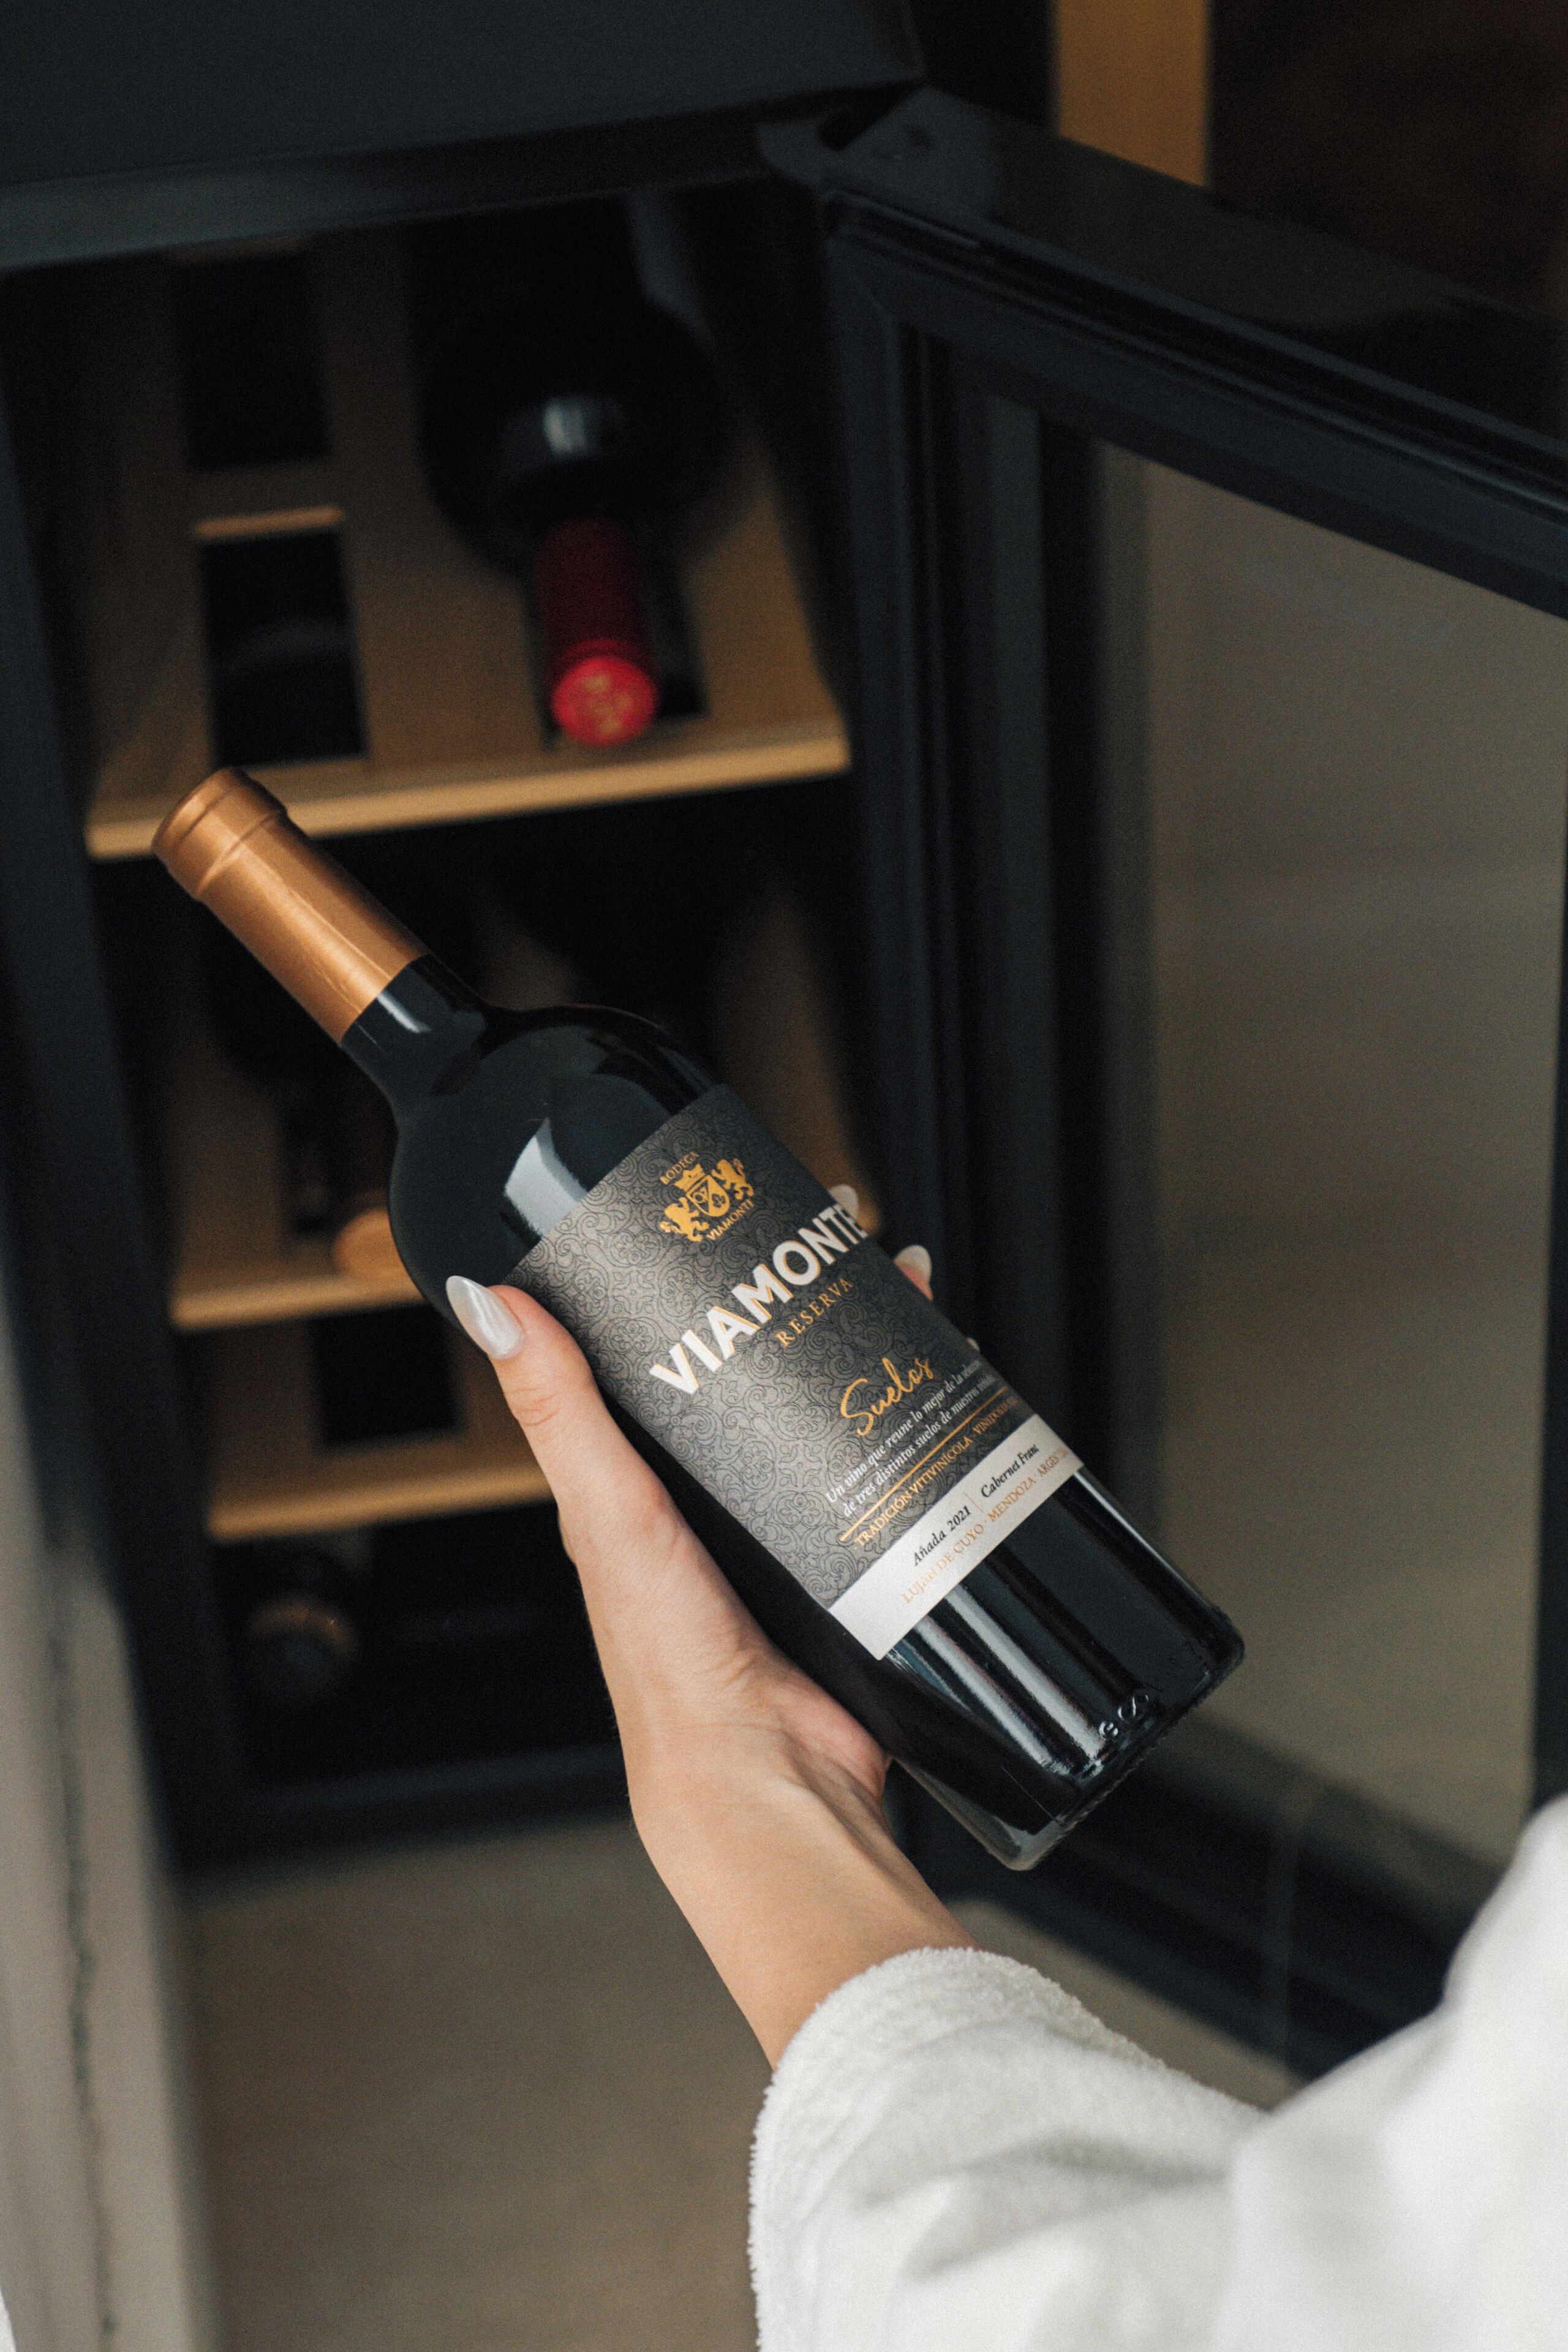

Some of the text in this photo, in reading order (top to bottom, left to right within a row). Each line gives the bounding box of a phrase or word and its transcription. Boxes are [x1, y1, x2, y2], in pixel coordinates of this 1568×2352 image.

[659, 1152, 699, 1185] BODEGA
[649, 1204, 869, 1394] VIAMONTE
[776, 1278, 853, 1348] RESERVA
[826, 1484, 846, 1502] Un
[844, 1462, 867, 1487] vino
[868, 1445, 886, 1467] que
[910, 1411, 923, 1423] lo
[922, 1389, 946, 1414] mejor
[944, 1380, 957, 1393] de
[952, 1374, 963, 1385] la
[840, 1357, 933, 1436] Suelos
[843, 1501, 857, 1517] de
[855, 1483, 876, 1504] tres
[876, 1444, 916, 1486] distintos
[915, 1422, 941, 1448] suelos
[940, 1411, 952, 1424] de
[951, 1387, 980, 1414] nuestros
[854, 1490, 913, 1546] TRADICIÓN
[913, 1444, 1039, 1566] Añada 2021 Cabernet Franc
[937, 1551, 956, 1571] DE
[953, 1523, 984, 1554] CUYO
[987, 1477, 1037, 1522] MENDOZA
